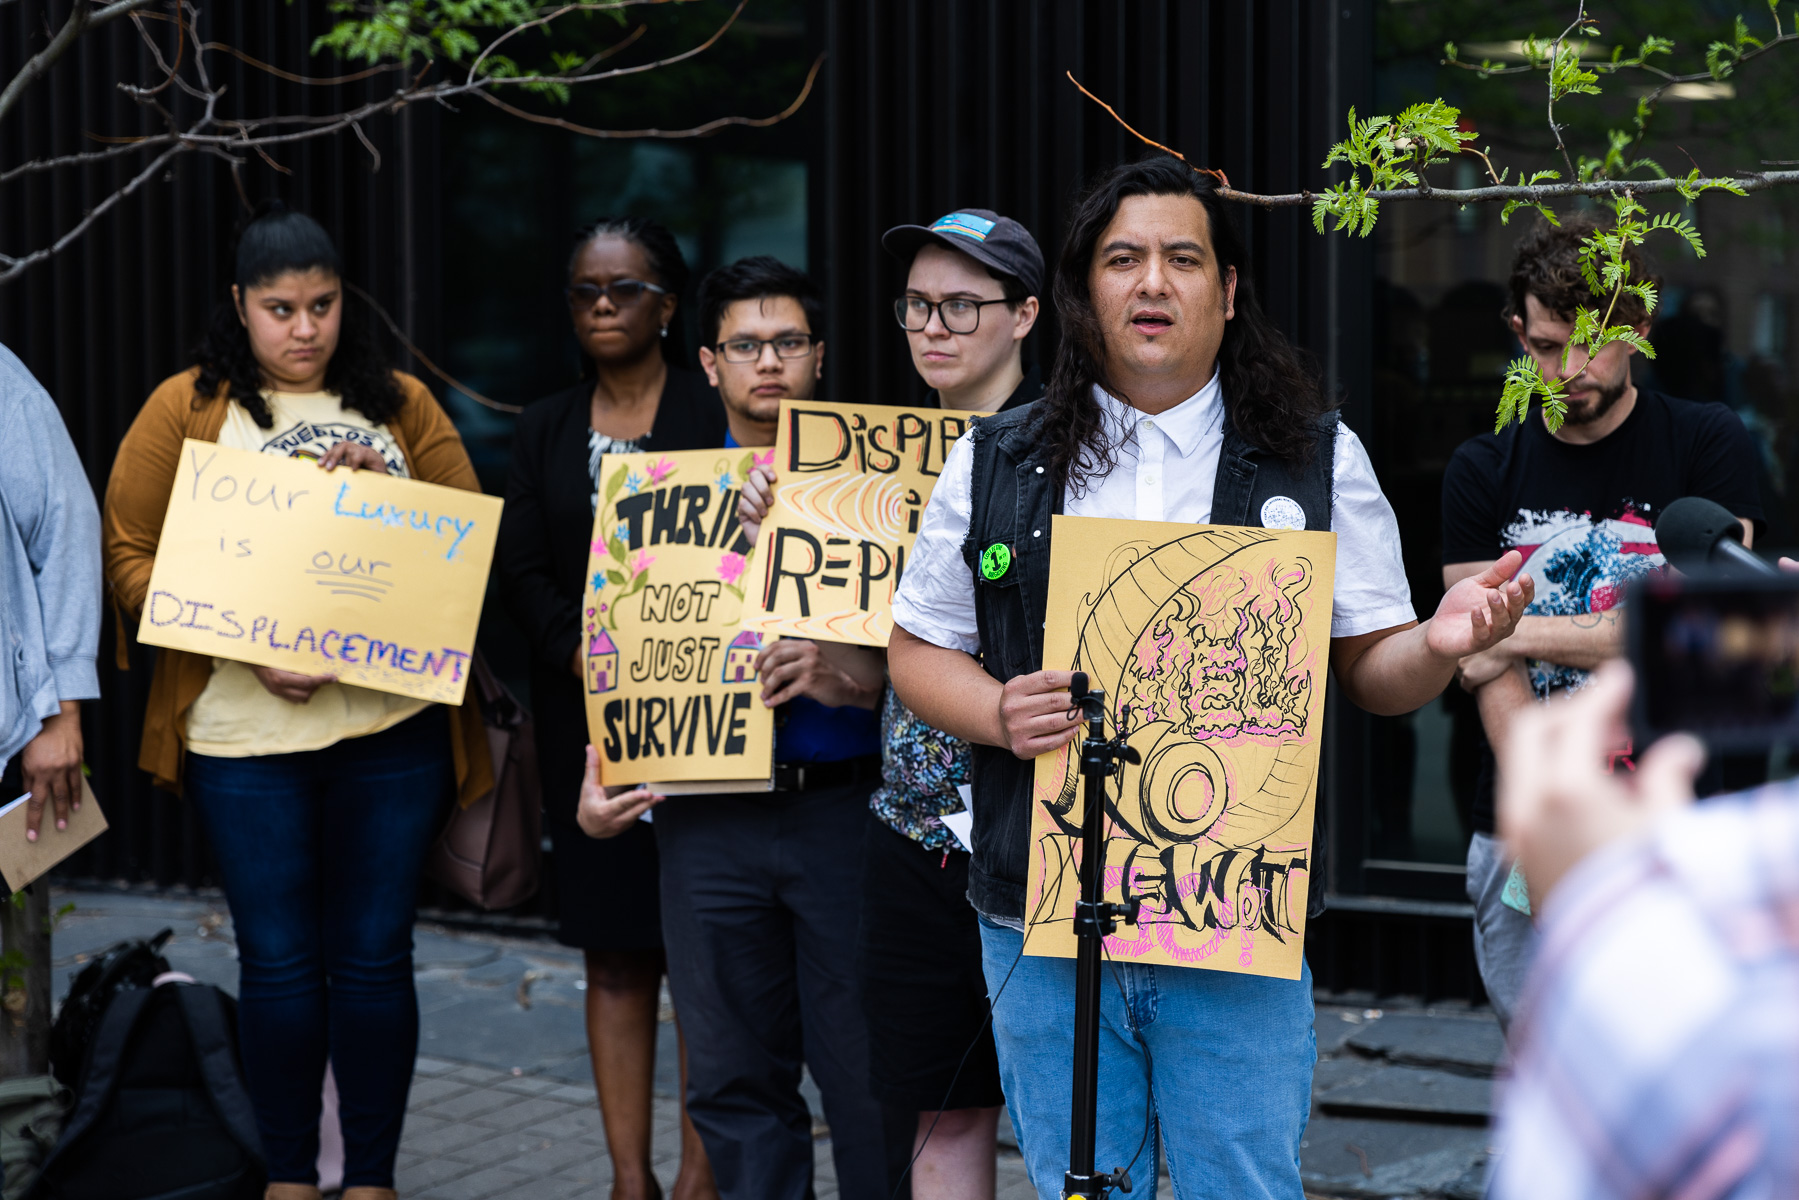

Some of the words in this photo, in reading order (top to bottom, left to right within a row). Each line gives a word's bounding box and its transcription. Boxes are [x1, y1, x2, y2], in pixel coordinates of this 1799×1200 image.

[190, 448, 309, 511] Your
[333, 482, 475, 560] Luxury
[219, 535, 253, 558] is
[311, 551, 391, 576] our
[641, 581, 721, 622] NOT
[149, 590, 471, 682] DISPLACEMENT
[631, 638, 721, 683] JUST
[603, 692, 752, 762] SURVIVE
